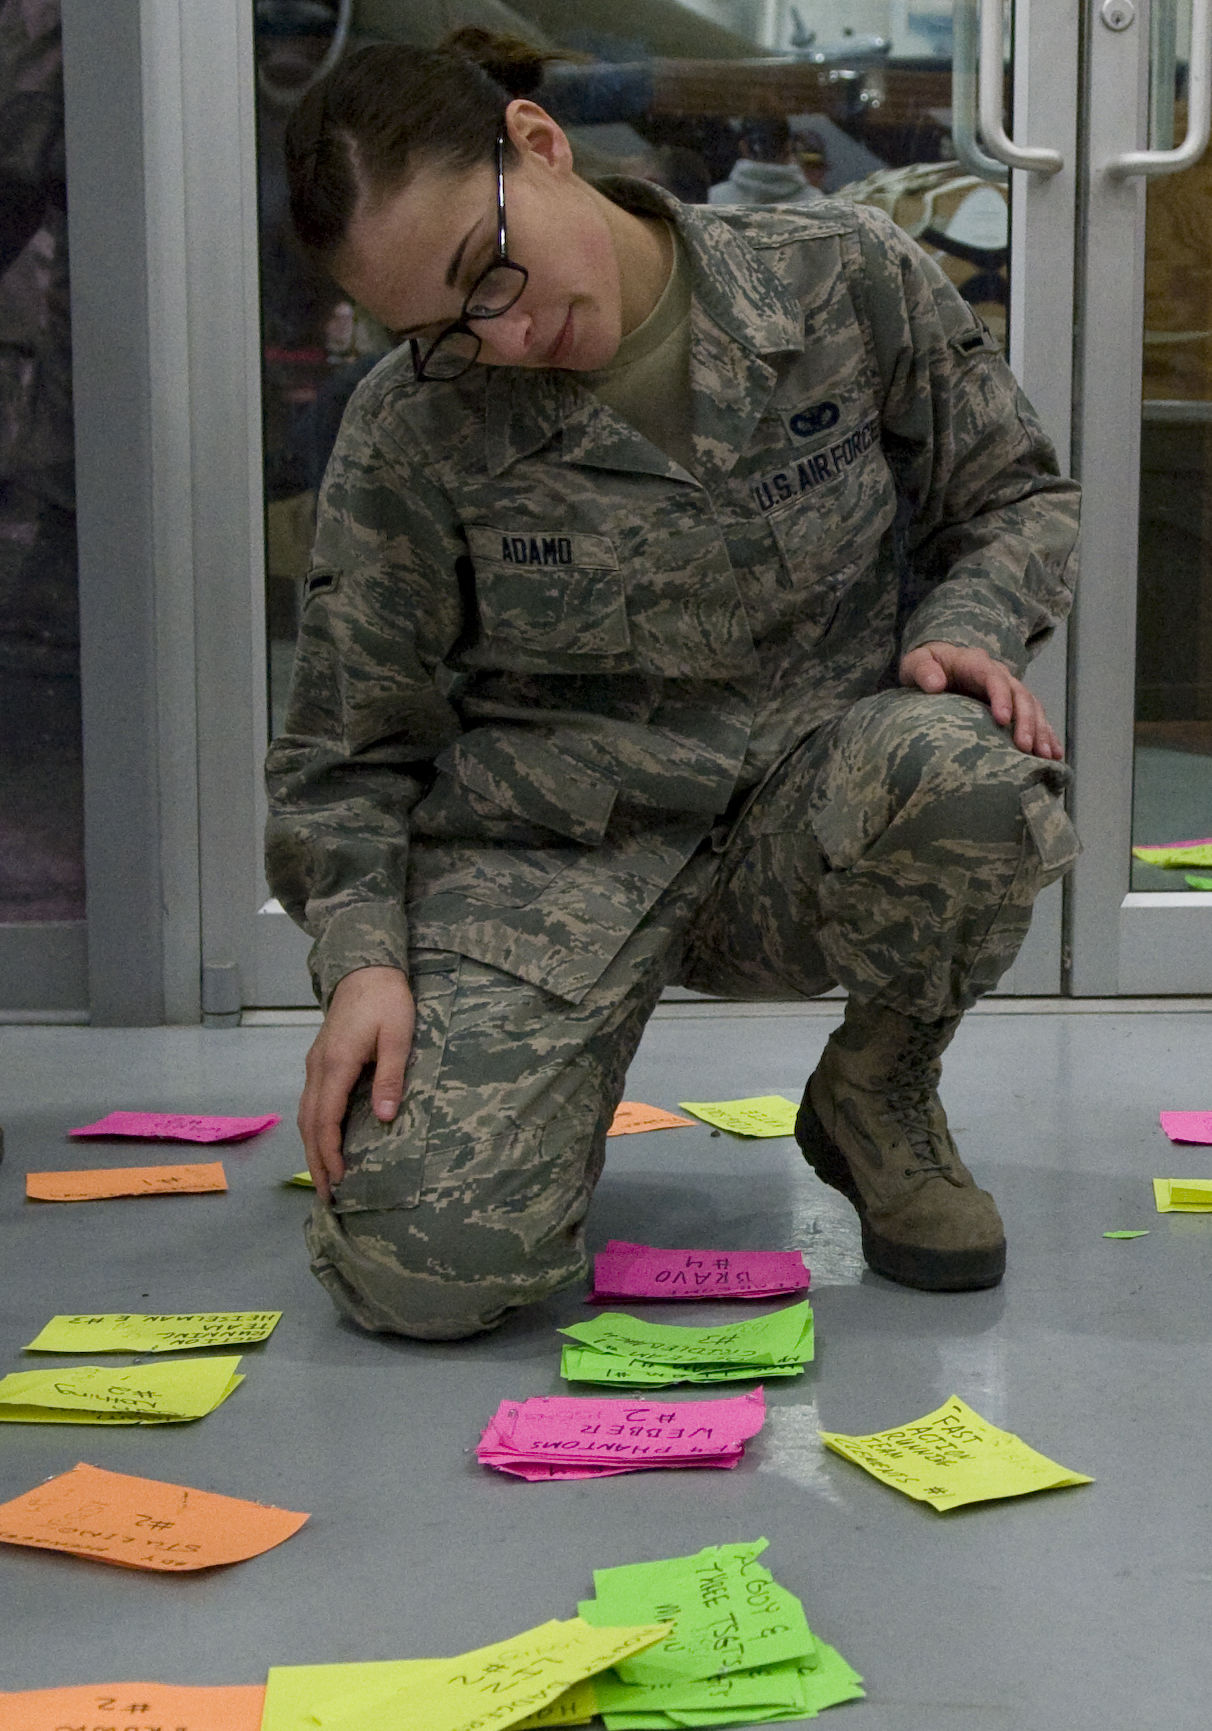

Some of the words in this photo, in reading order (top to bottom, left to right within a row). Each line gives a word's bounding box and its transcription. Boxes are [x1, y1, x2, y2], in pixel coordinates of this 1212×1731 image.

[755, 473, 798, 511] U.S.
[797, 453, 832, 492] AIR
[830, 420, 880, 473] FORCE
[502, 536, 573, 566] ADAMO
[654, 1269, 751, 1285] BRAVO
[623, 1408, 675, 1423] #2
[578, 1424, 713, 1440] WEBBER
[932, 1414, 984, 1443] FAST
[529, 1441, 671, 1455] PHANTOMS
[94, 1697, 151, 1716] #2
